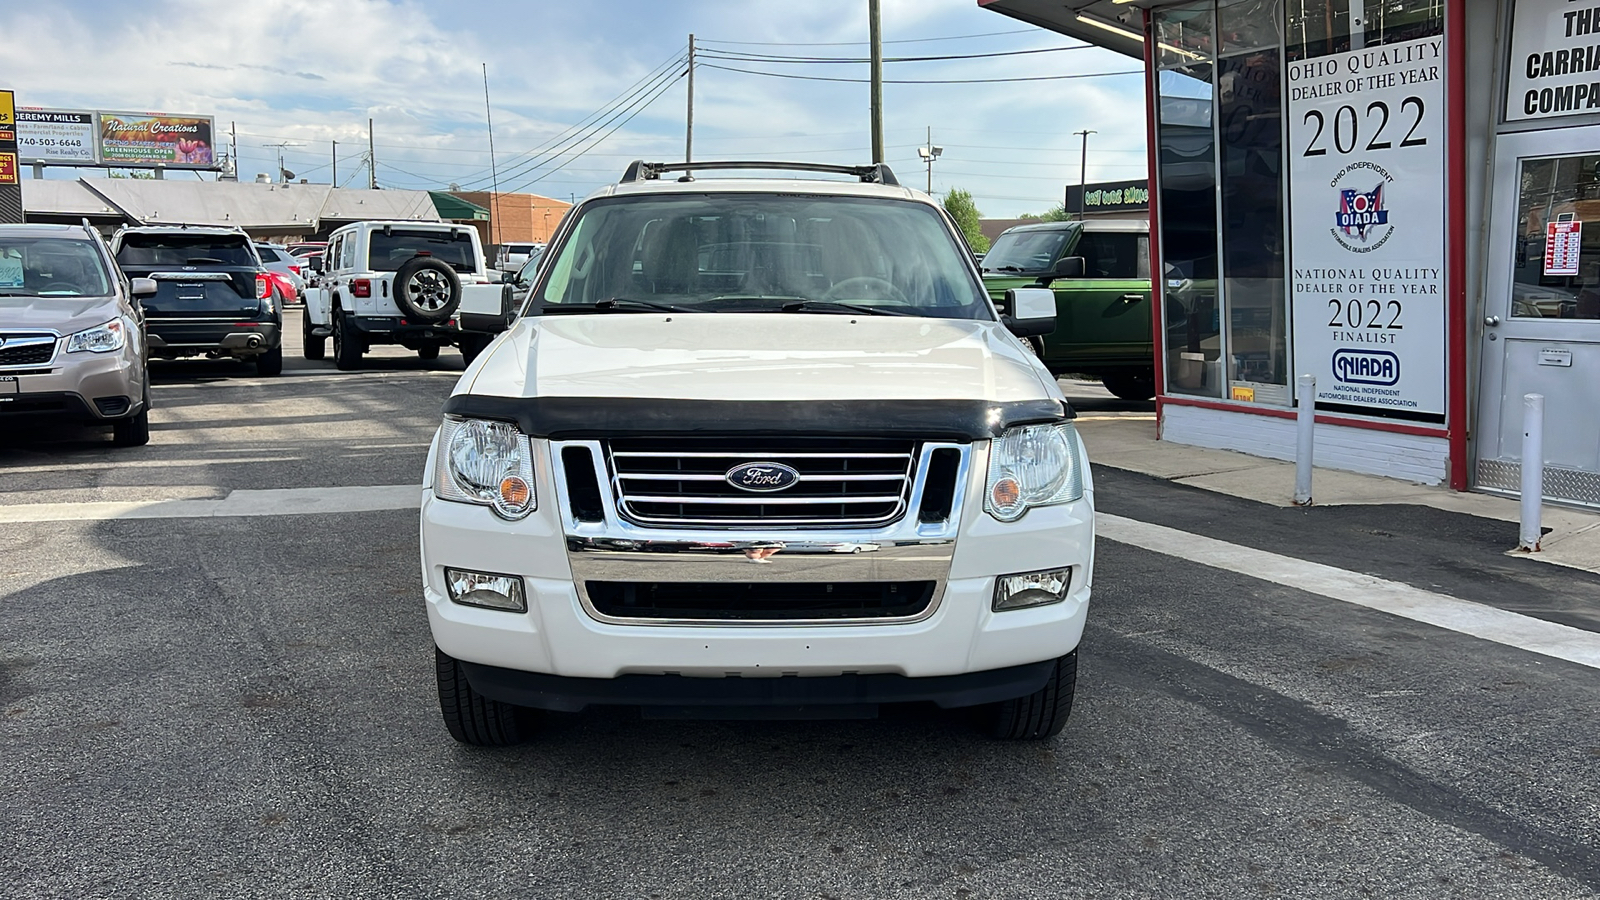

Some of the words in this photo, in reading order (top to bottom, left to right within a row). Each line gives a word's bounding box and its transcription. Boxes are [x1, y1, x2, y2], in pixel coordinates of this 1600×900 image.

[1564, 8, 1600, 38] THE
[1290, 60, 1338, 81] OHIO
[1348, 41, 1442, 74] QUALITY
[1292, 81, 1342, 101] DEALER
[1346, 78, 1364, 93] OF
[1367, 73, 1396, 90] THE
[1399, 66, 1439, 85] YEAR
[1524, 82, 1600, 115] COMPA
[16, 113, 51, 121] JEREMY
[106, 120, 149, 132] Natural
[151, 121, 198, 133] Creations
[1303, 96, 1427, 157] 2022
[19, 138, 81, 147] 740-503-6648
[1330, 169, 1346, 188] OHIO
[1346, 162, 1394, 183] INDEPENDENT
[1342, 212, 1379, 225] OIADA
[1330, 228, 1351, 251] AUTOMOBILE
[1371, 225, 1395, 251] ASSOCIATION
[1295, 269, 1365, 279] NATIONAL
[1372, 269, 1439, 281] QUALITY
[1296, 284, 1343, 292] DEALER
[1349, 284, 1364, 293] OF
[1370, 284, 1395, 293] THE
[1402, 284, 1437, 294] YEAR
[1328, 299, 1403, 329] 2022
[1333, 331, 1396, 343] FINALIST
[1338, 356, 1393, 378] NIADA
[1319, 393, 1352, 401] AUTOMOBILE
[1378, 399, 1417, 407] ASSOCIATION
[1362, 387, 1400, 396] INDEPENDENT
[743, 468, 782, 485] Ford
